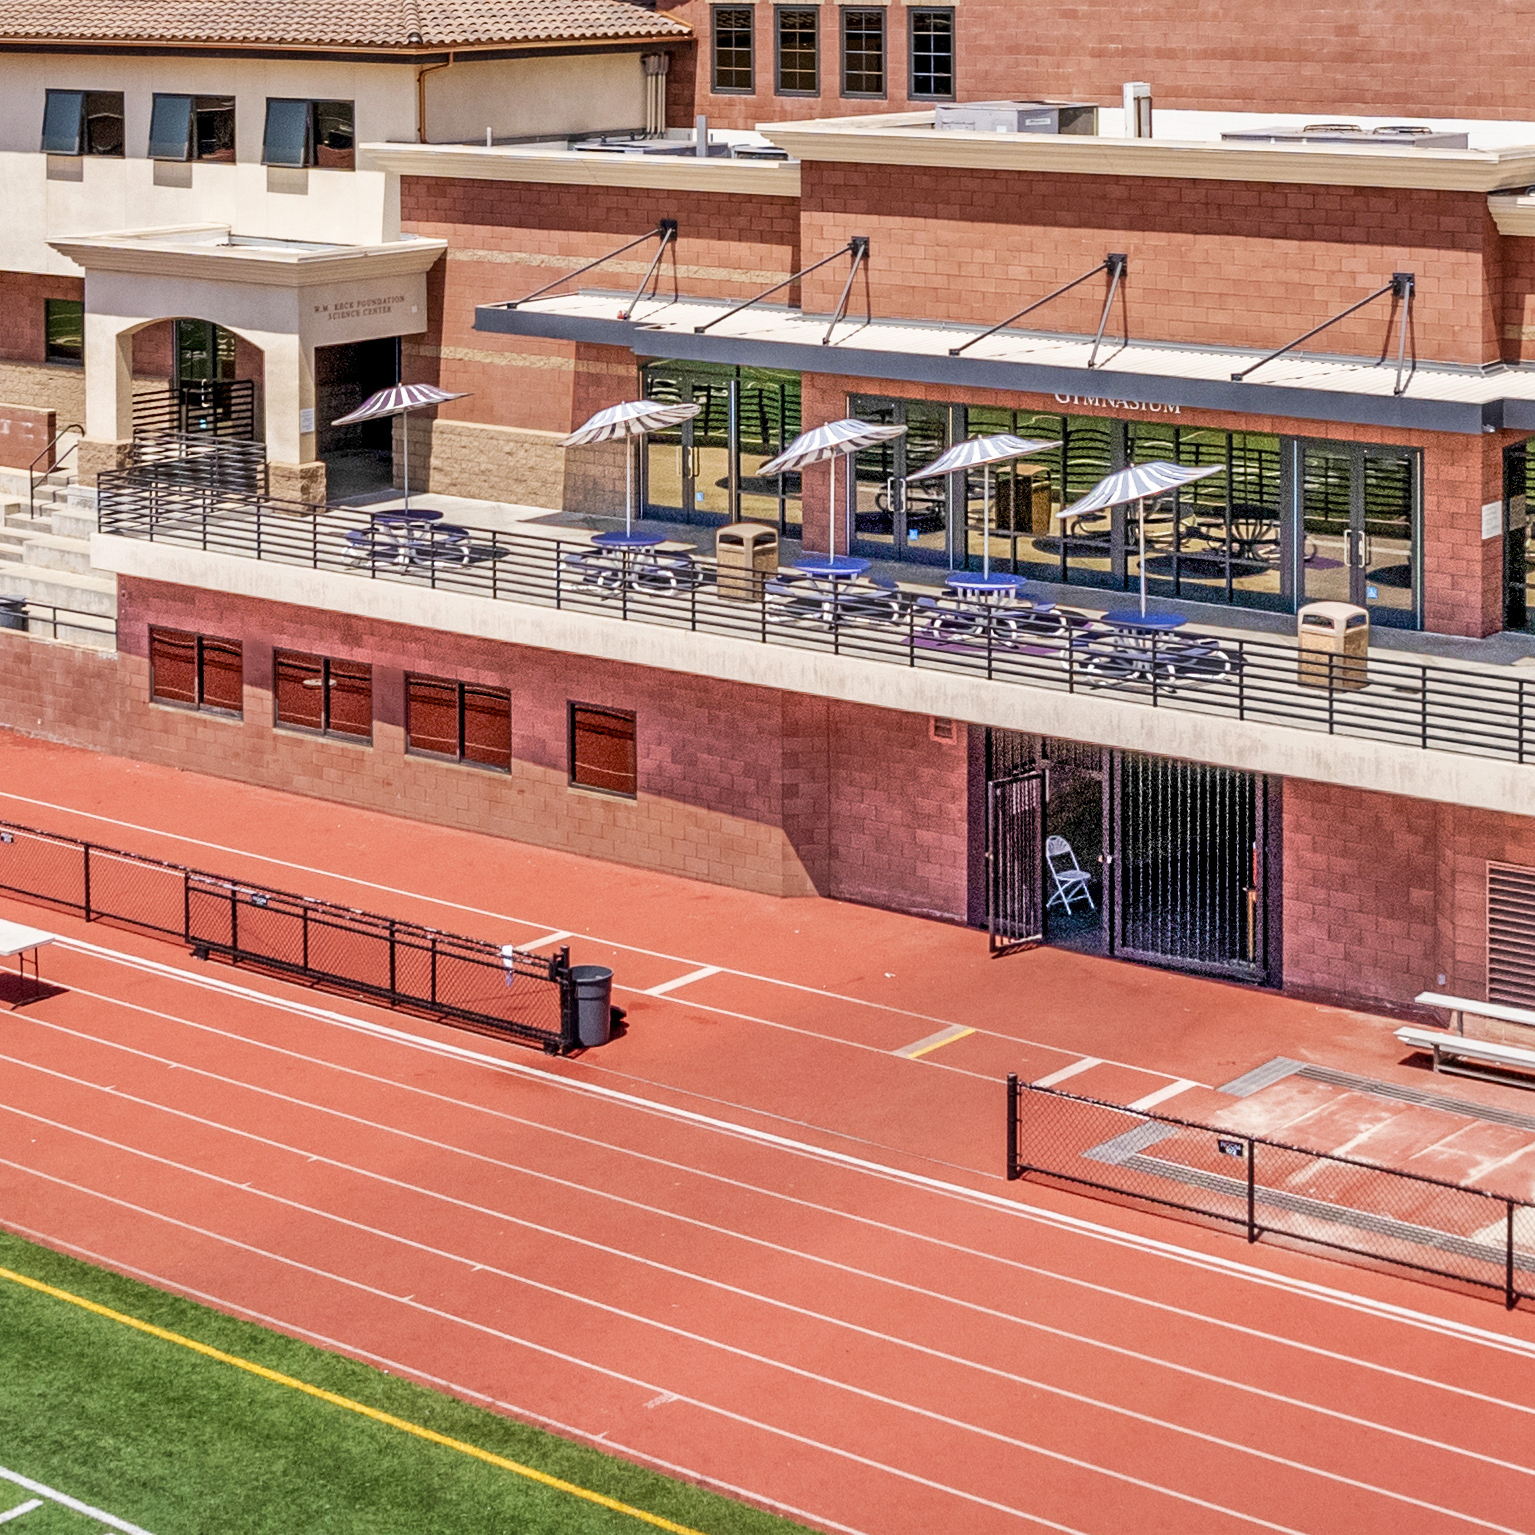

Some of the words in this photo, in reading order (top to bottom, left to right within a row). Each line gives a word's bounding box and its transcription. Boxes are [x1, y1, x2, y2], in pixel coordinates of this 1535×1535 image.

[334, 301, 354, 311] KECK
[356, 295, 405, 308] FOUNDATION
[328, 310, 360, 320] SCIENCE
[363, 306, 392, 316] CENTER
